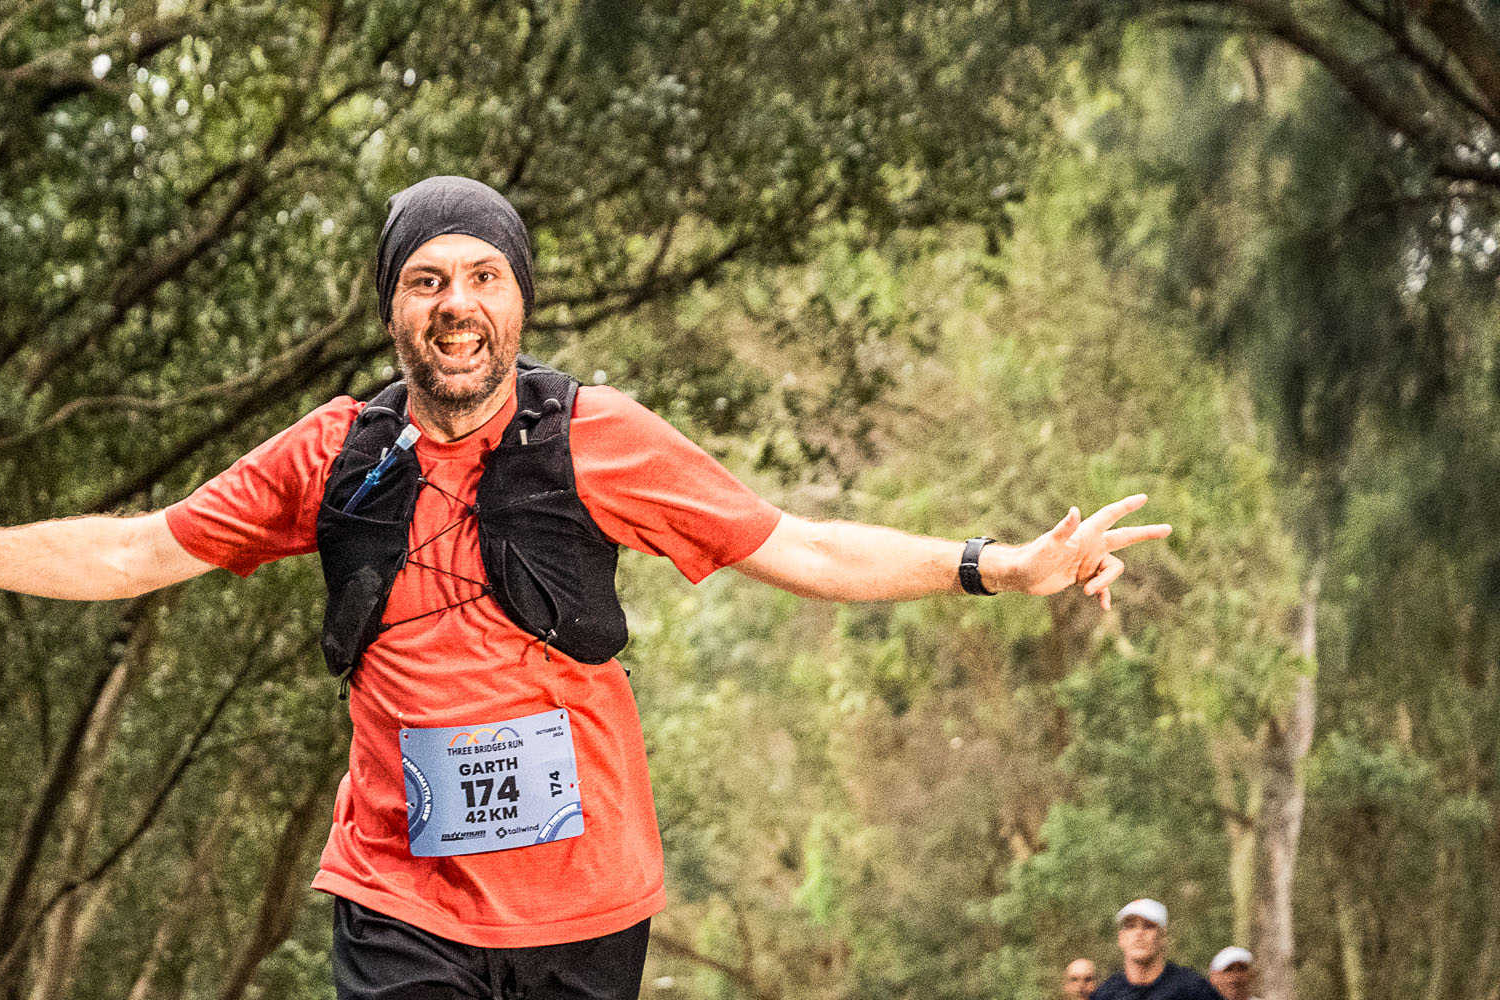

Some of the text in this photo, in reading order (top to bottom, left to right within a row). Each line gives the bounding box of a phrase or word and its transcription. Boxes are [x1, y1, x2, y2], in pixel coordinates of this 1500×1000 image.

[447, 739, 524, 756] THREE BRIDGES RUN
[459, 757, 518, 776] GARTH
[460, 775, 520, 808] 174
[549, 770, 563, 797] 174
[422, 803, 432, 822] NSW
[465, 805, 519, 824] 42 KM
[508, 824, 540, 835] tailwind
